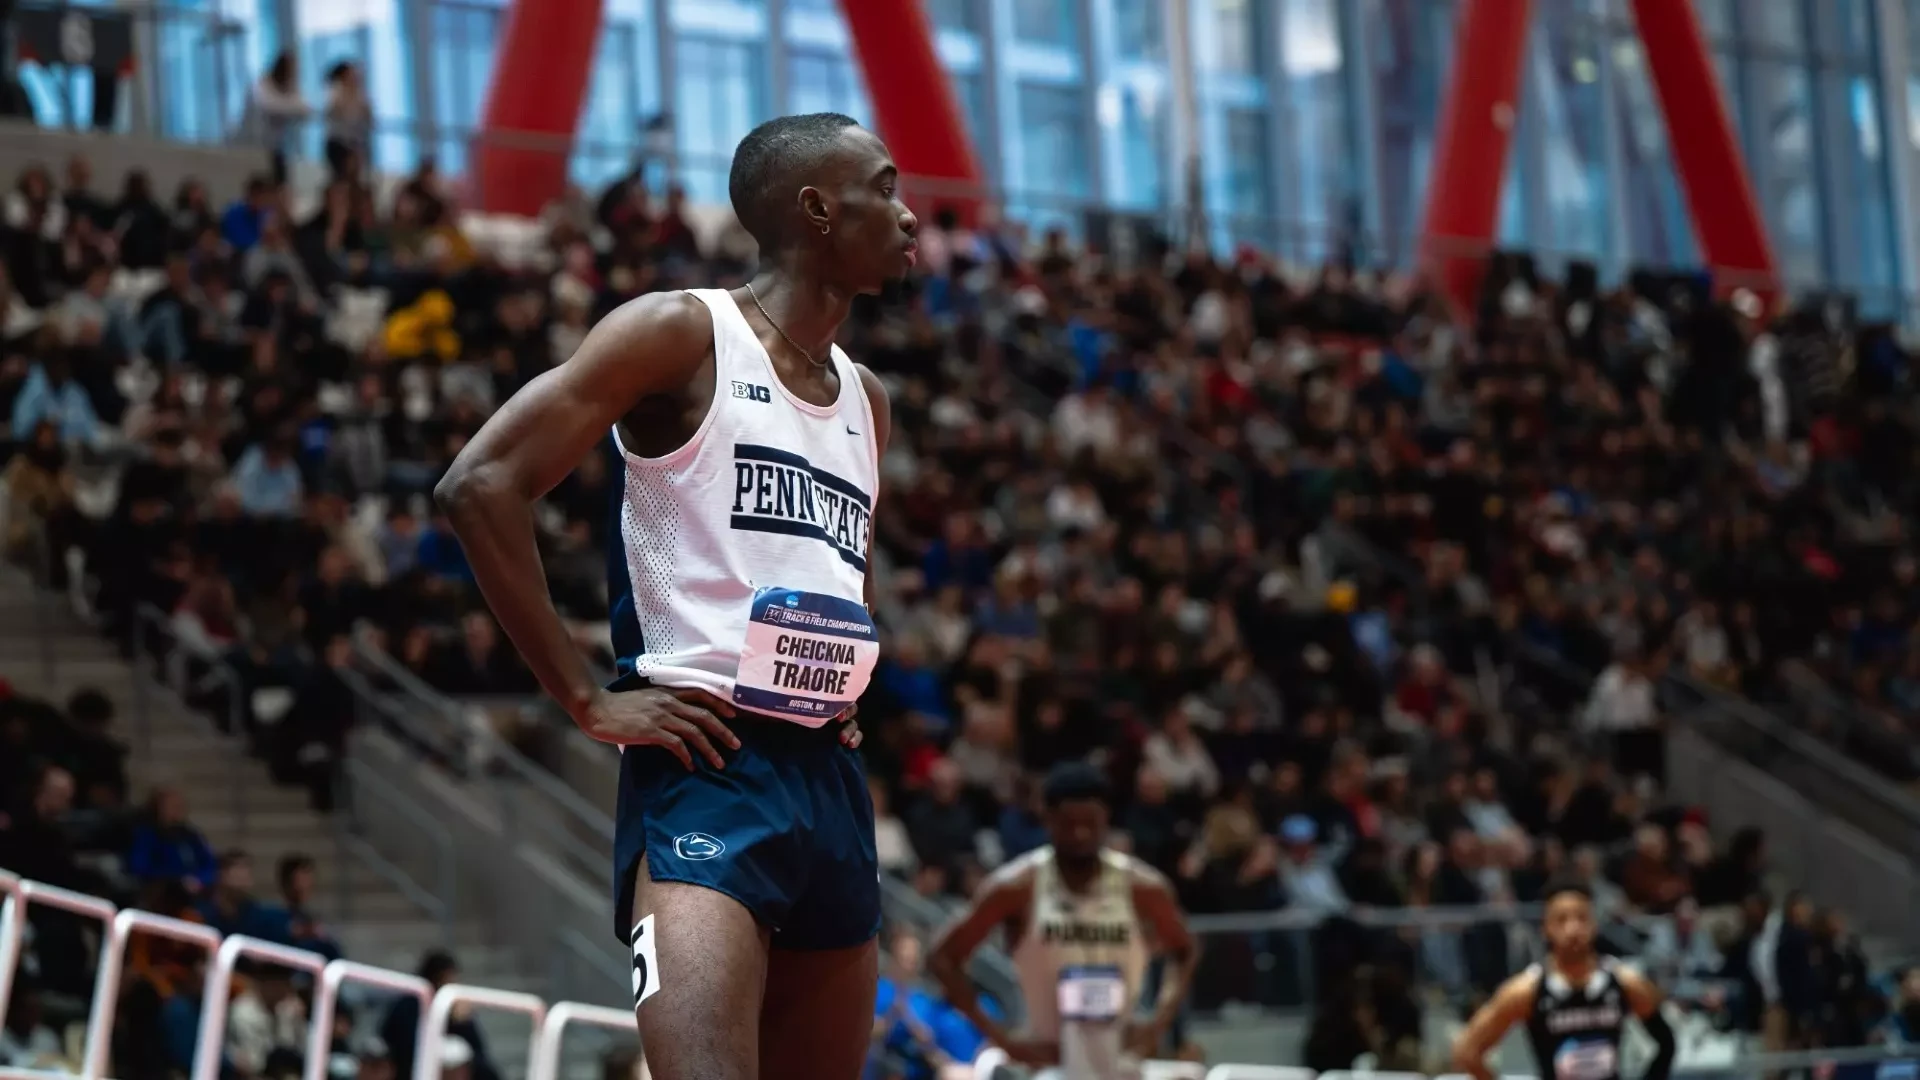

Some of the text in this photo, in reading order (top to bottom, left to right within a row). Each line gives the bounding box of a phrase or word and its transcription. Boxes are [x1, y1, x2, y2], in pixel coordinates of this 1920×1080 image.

[732, 462, 870, 558] PENN STATE
[781, 611, 806, 624] TRACK
[809, 616, 827, 627] FIELD
[826, 619, 871, 634] CHAMPIONSHIPS
[776, 634, 855, 665] CHEICKNA
[773, 660, 850, 695] TRAORE
[788, 699, 814, 711] BOSTON,
[632, 924, 647, 1002] 5
